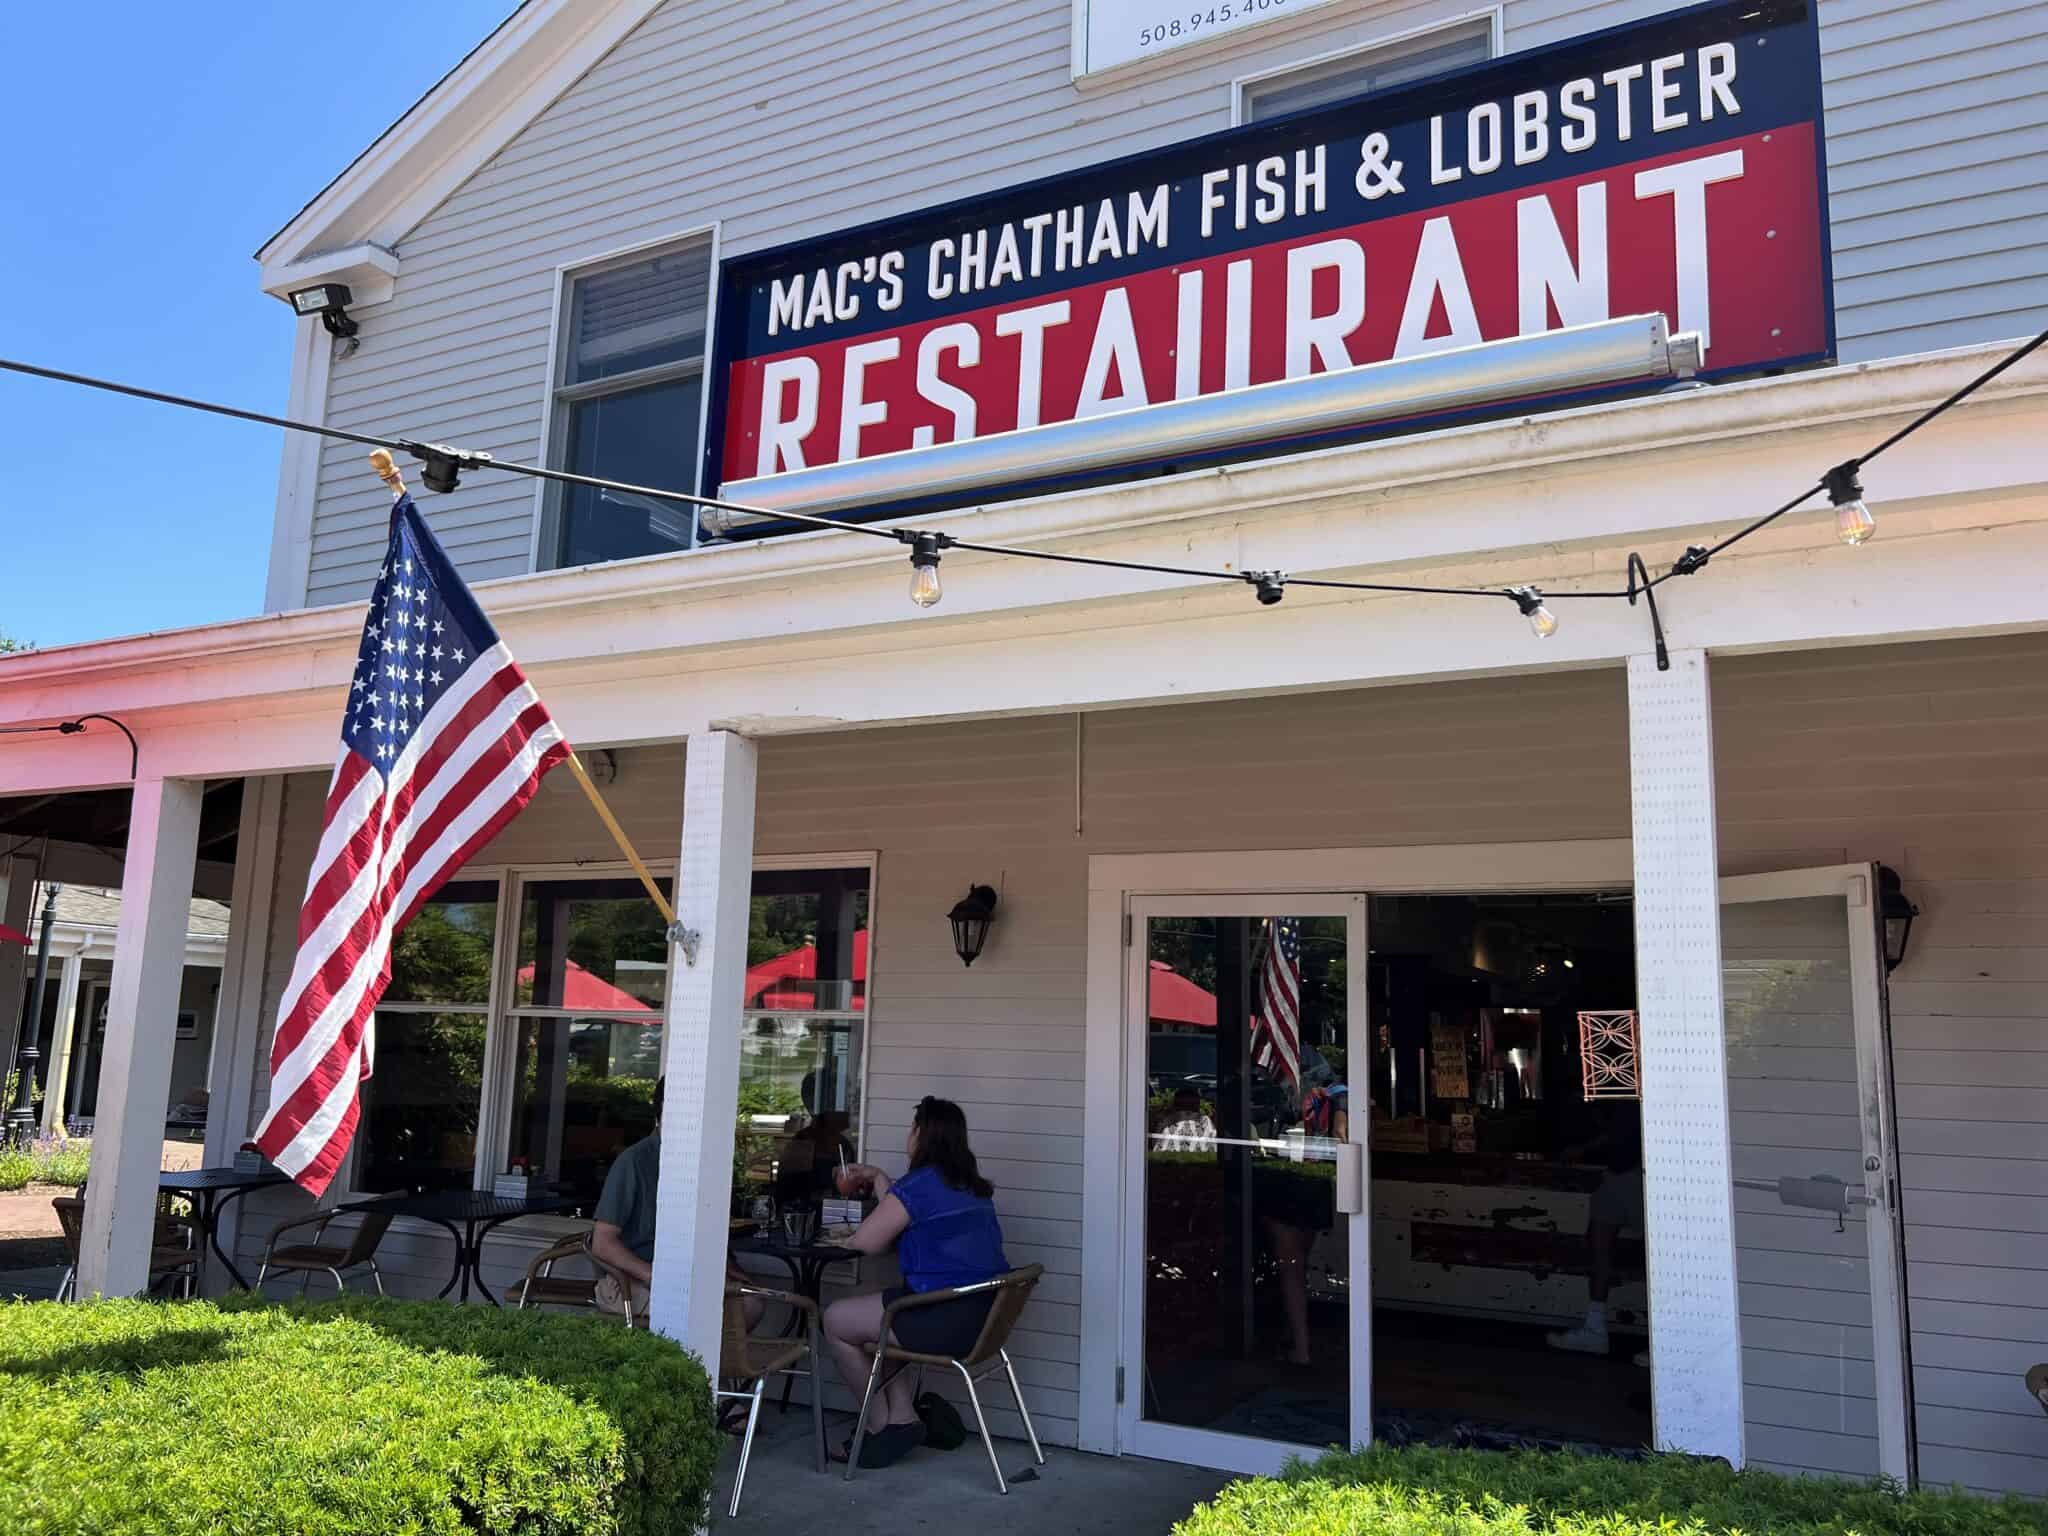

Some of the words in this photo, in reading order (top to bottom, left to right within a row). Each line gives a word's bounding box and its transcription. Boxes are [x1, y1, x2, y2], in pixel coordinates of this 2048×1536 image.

[1139, 0, 1286, 46] 508.945.40
[755, 149, 1745, 477] RESTAURANT
[767, 250, 905, 337] MAC'S
[926, 183, 1170, 300] CHATHAM
[1200, 144, 1327, 238] FISH
[1355, 131, 1405, 201] &
[1429, 41, 1742, 185] LOBSTER
